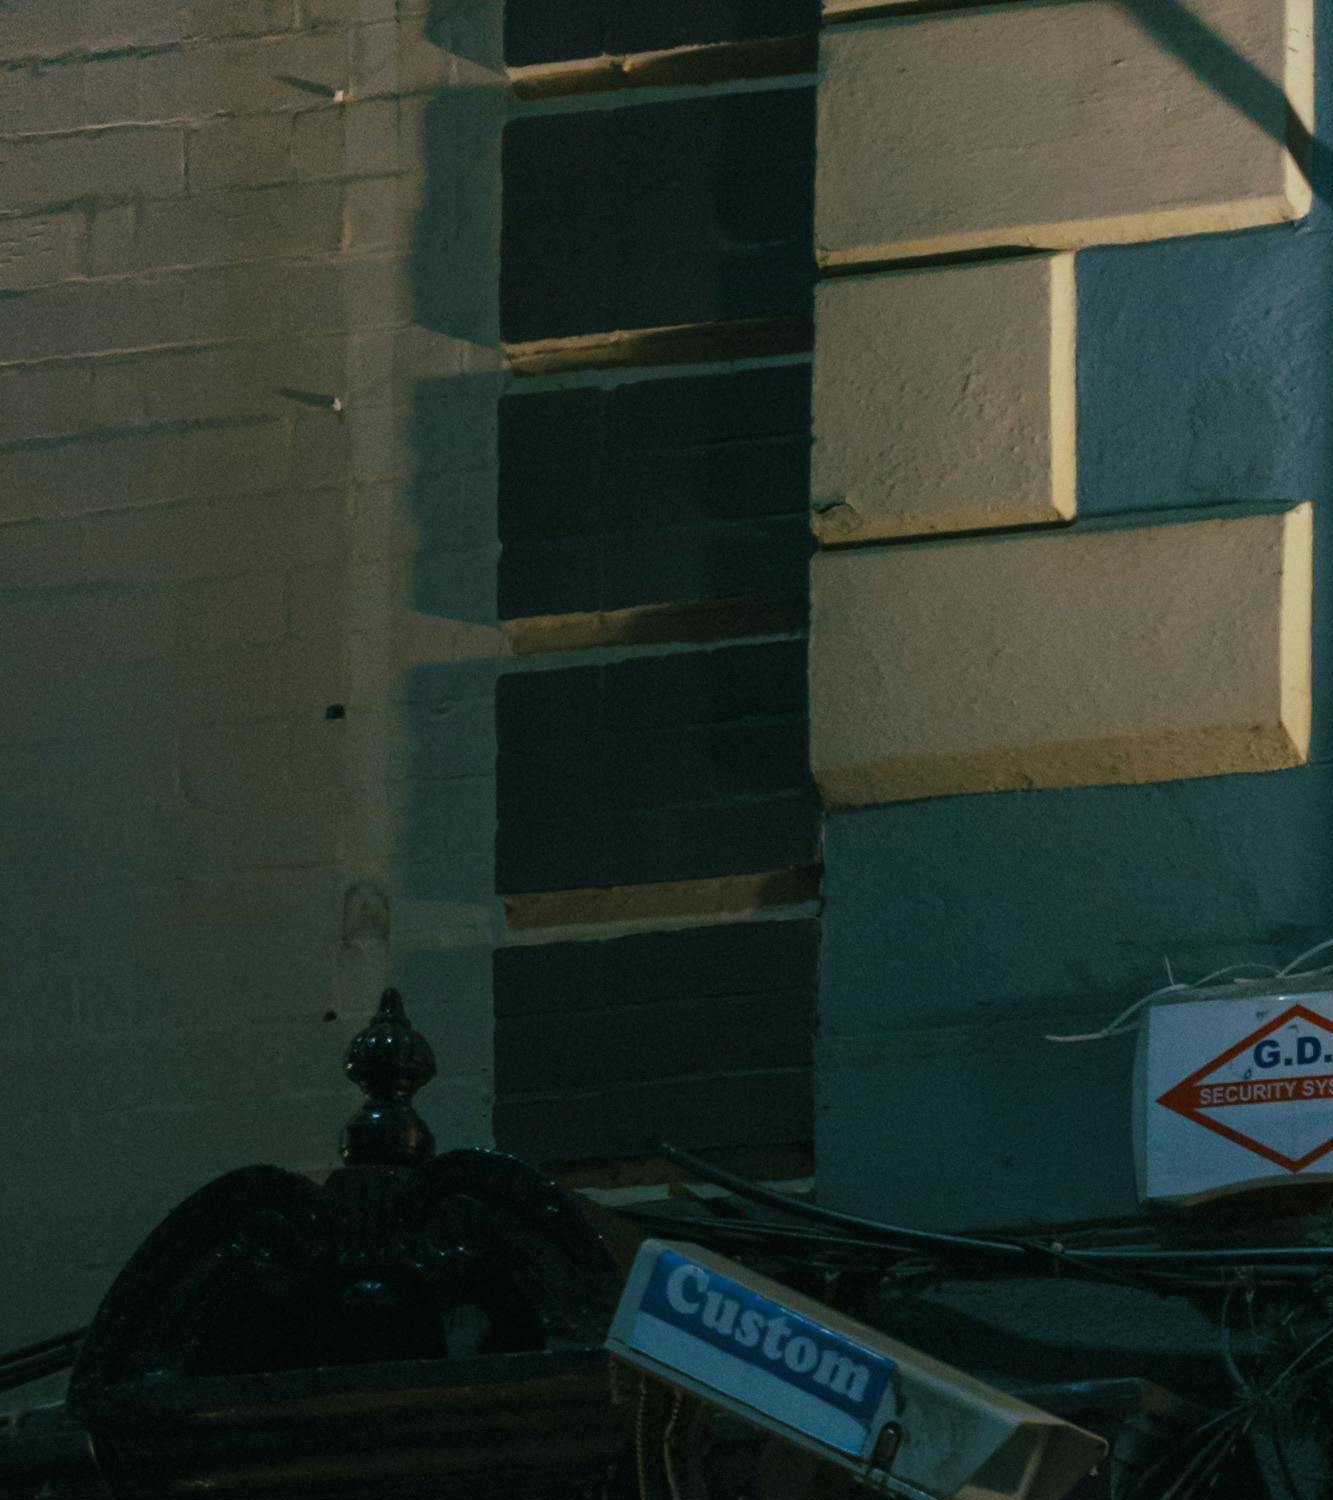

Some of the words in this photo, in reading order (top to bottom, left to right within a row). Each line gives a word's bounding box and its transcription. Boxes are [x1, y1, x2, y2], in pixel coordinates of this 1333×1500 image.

[1252, 1036, 1333, 1069] G.D.
[1199, 1079, 1296, 1106] SECURITY
[666, 1264, 872, 1402] Custom
